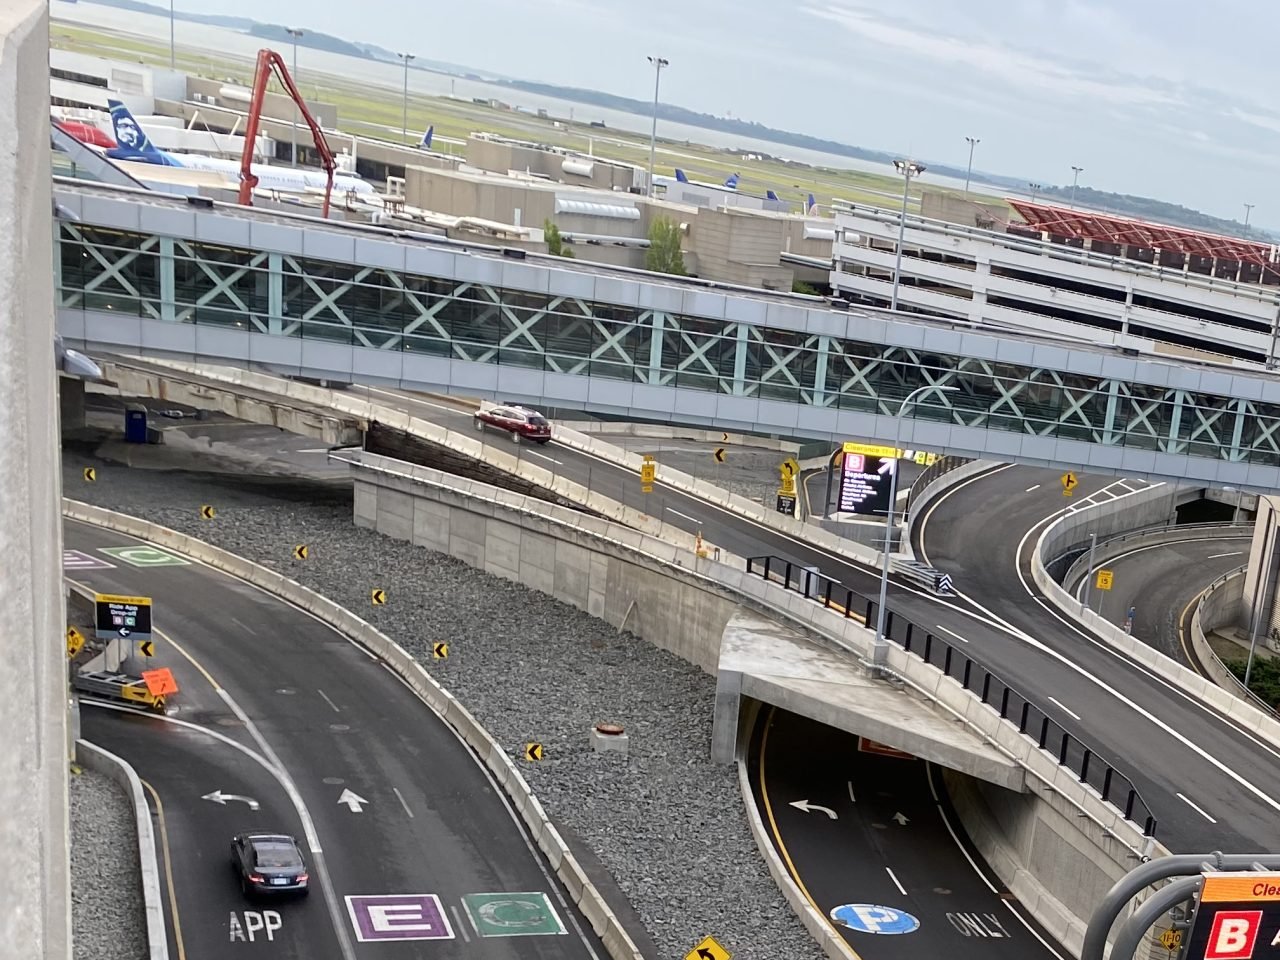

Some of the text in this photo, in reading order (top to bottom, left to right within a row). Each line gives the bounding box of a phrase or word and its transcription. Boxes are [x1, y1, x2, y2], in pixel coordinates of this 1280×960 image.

[849, 455, 861, 469] B
[845, 471, 880, 480] Departures
[119, 550, 172, 563] C
[229, 910, 283, 942] APP
[367, 904, 431, 932] E
[478, 900, 546, 927] C
[851, 906, 899, 931] P
[945, 912, 1021, 937] ONLY
[1214, 918, 1250, 953] B
